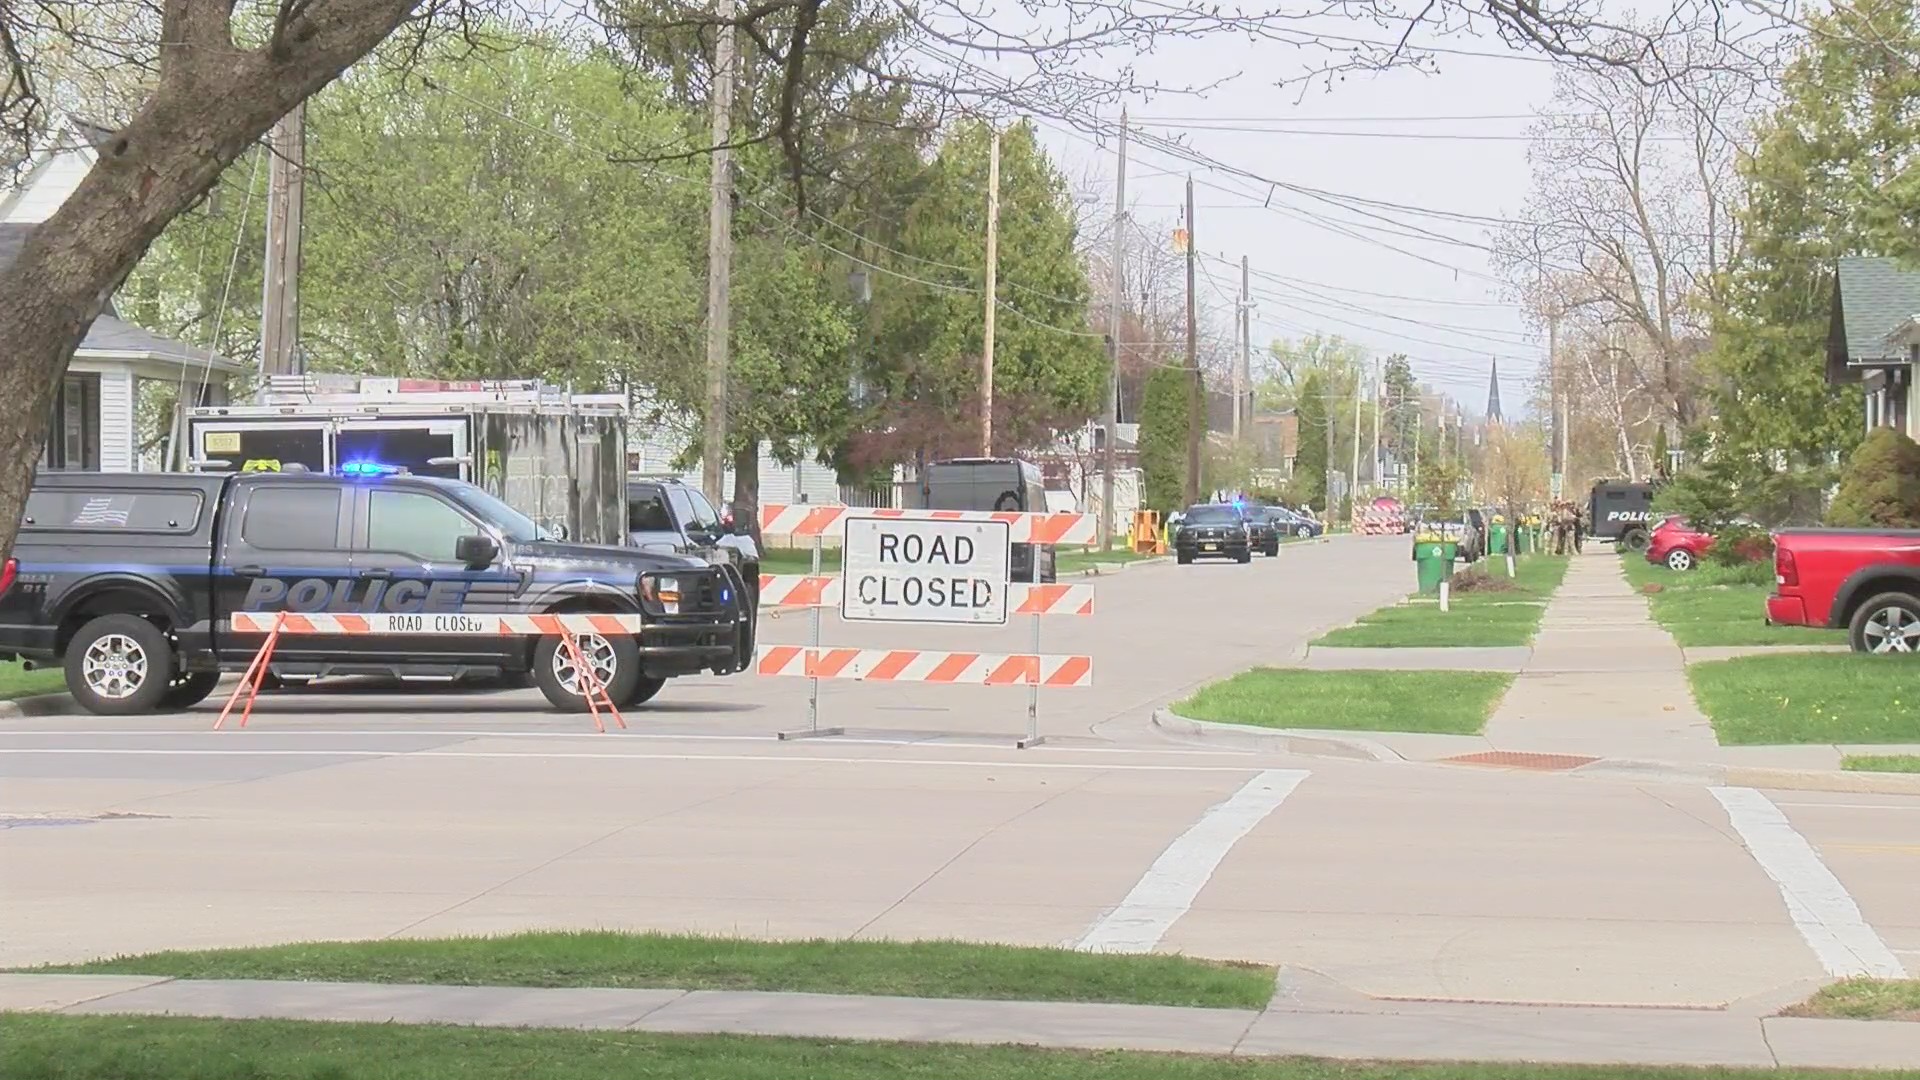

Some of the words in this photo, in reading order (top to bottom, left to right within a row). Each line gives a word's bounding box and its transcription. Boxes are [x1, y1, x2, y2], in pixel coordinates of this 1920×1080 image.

[1607, 511, 1662, 521] POLIC
[879, 533, 974, 565] ROAD
[242, 578, 466, 612] POLICE
[858, 575, 992, 608] CLOSED
[389, 615, 422, 631] ROAD
